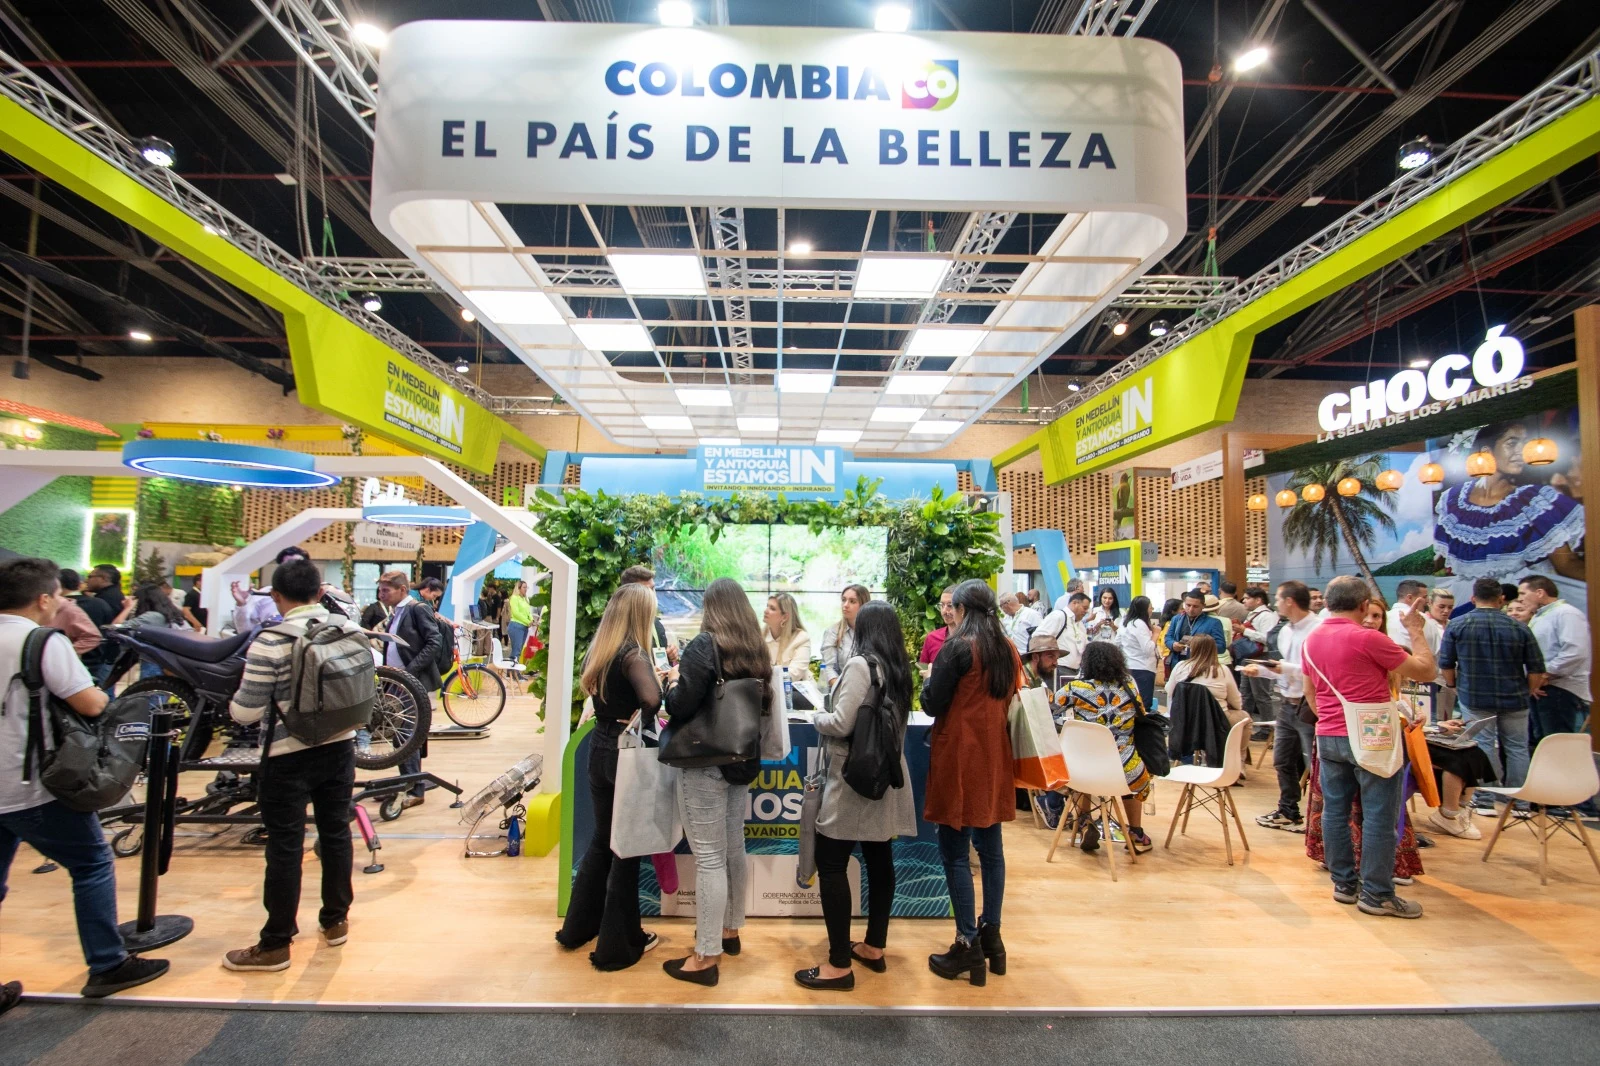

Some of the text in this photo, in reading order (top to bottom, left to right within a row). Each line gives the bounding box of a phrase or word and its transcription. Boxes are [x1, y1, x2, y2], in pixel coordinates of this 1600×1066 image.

[604, 60, 891, 100] COLOMBIA
[441, 110, 1117, 169] EL PAÍS DE LA BELLEZA
[387, 360, 440, 402] EN MEDELLÍN
[387, 376, 440, 416] Y ANTIOQUIA
[1317, 324, 1526, 433] CHOCÓ
[384, 390, 465, 444] ESTAMOS IN
[1075, 376, 1153, 457] ESTAMOS IN
[1076, 394, 1120, 428] EN MEDELLÍN
[1076, 409, 1122, 441] Y ANTIOQUIA
[1316, 375, 1535, 444] LA SELVA DE LOS 2 MARES
[703, 449, 835, 484] ESTAMOS IN
[704, 447, 722, 458] EN
[704, 459, 789, 471] Y ANTIOQUIA
[1099, 564, 1132, 585] ESTAMOS IN
